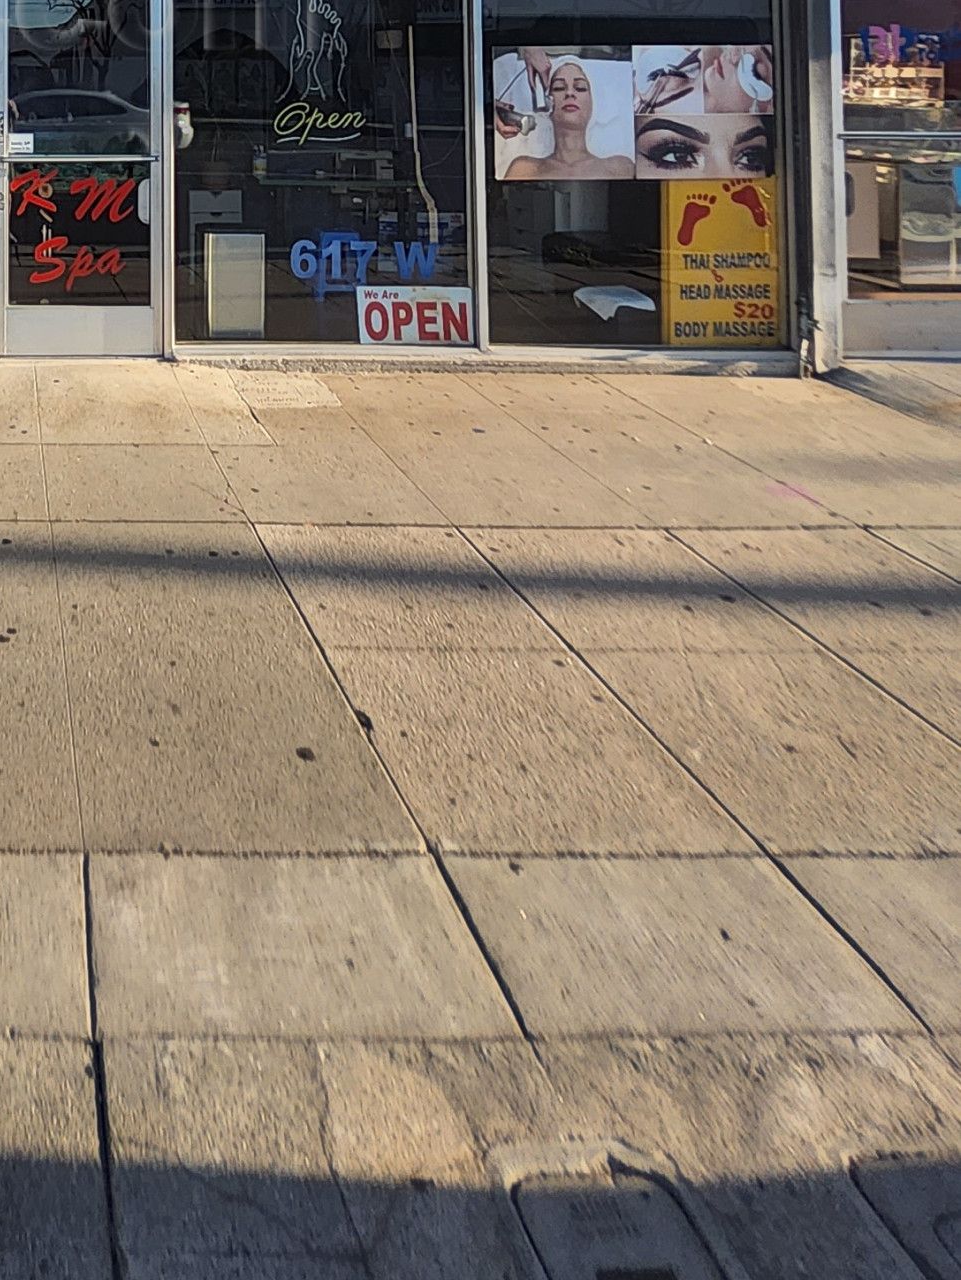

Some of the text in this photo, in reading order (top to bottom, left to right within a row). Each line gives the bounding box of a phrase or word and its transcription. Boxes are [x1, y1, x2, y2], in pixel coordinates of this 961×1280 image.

[274, 102, 367, 146] Open
[29, 236, 128, 292] Spa
[290, 239, 439, 281] 617 W
[683, 252, 771, 270] THAI SHAMPOO
[364, 289, 399, 300] We Are
[680, 284, 771, 300] HEAD MASSAGE
[733, 301, 775, 320] $20
[364, 301, 470, 342] OPEN
[674, 321, 775, 338] BODY MASSAGE
